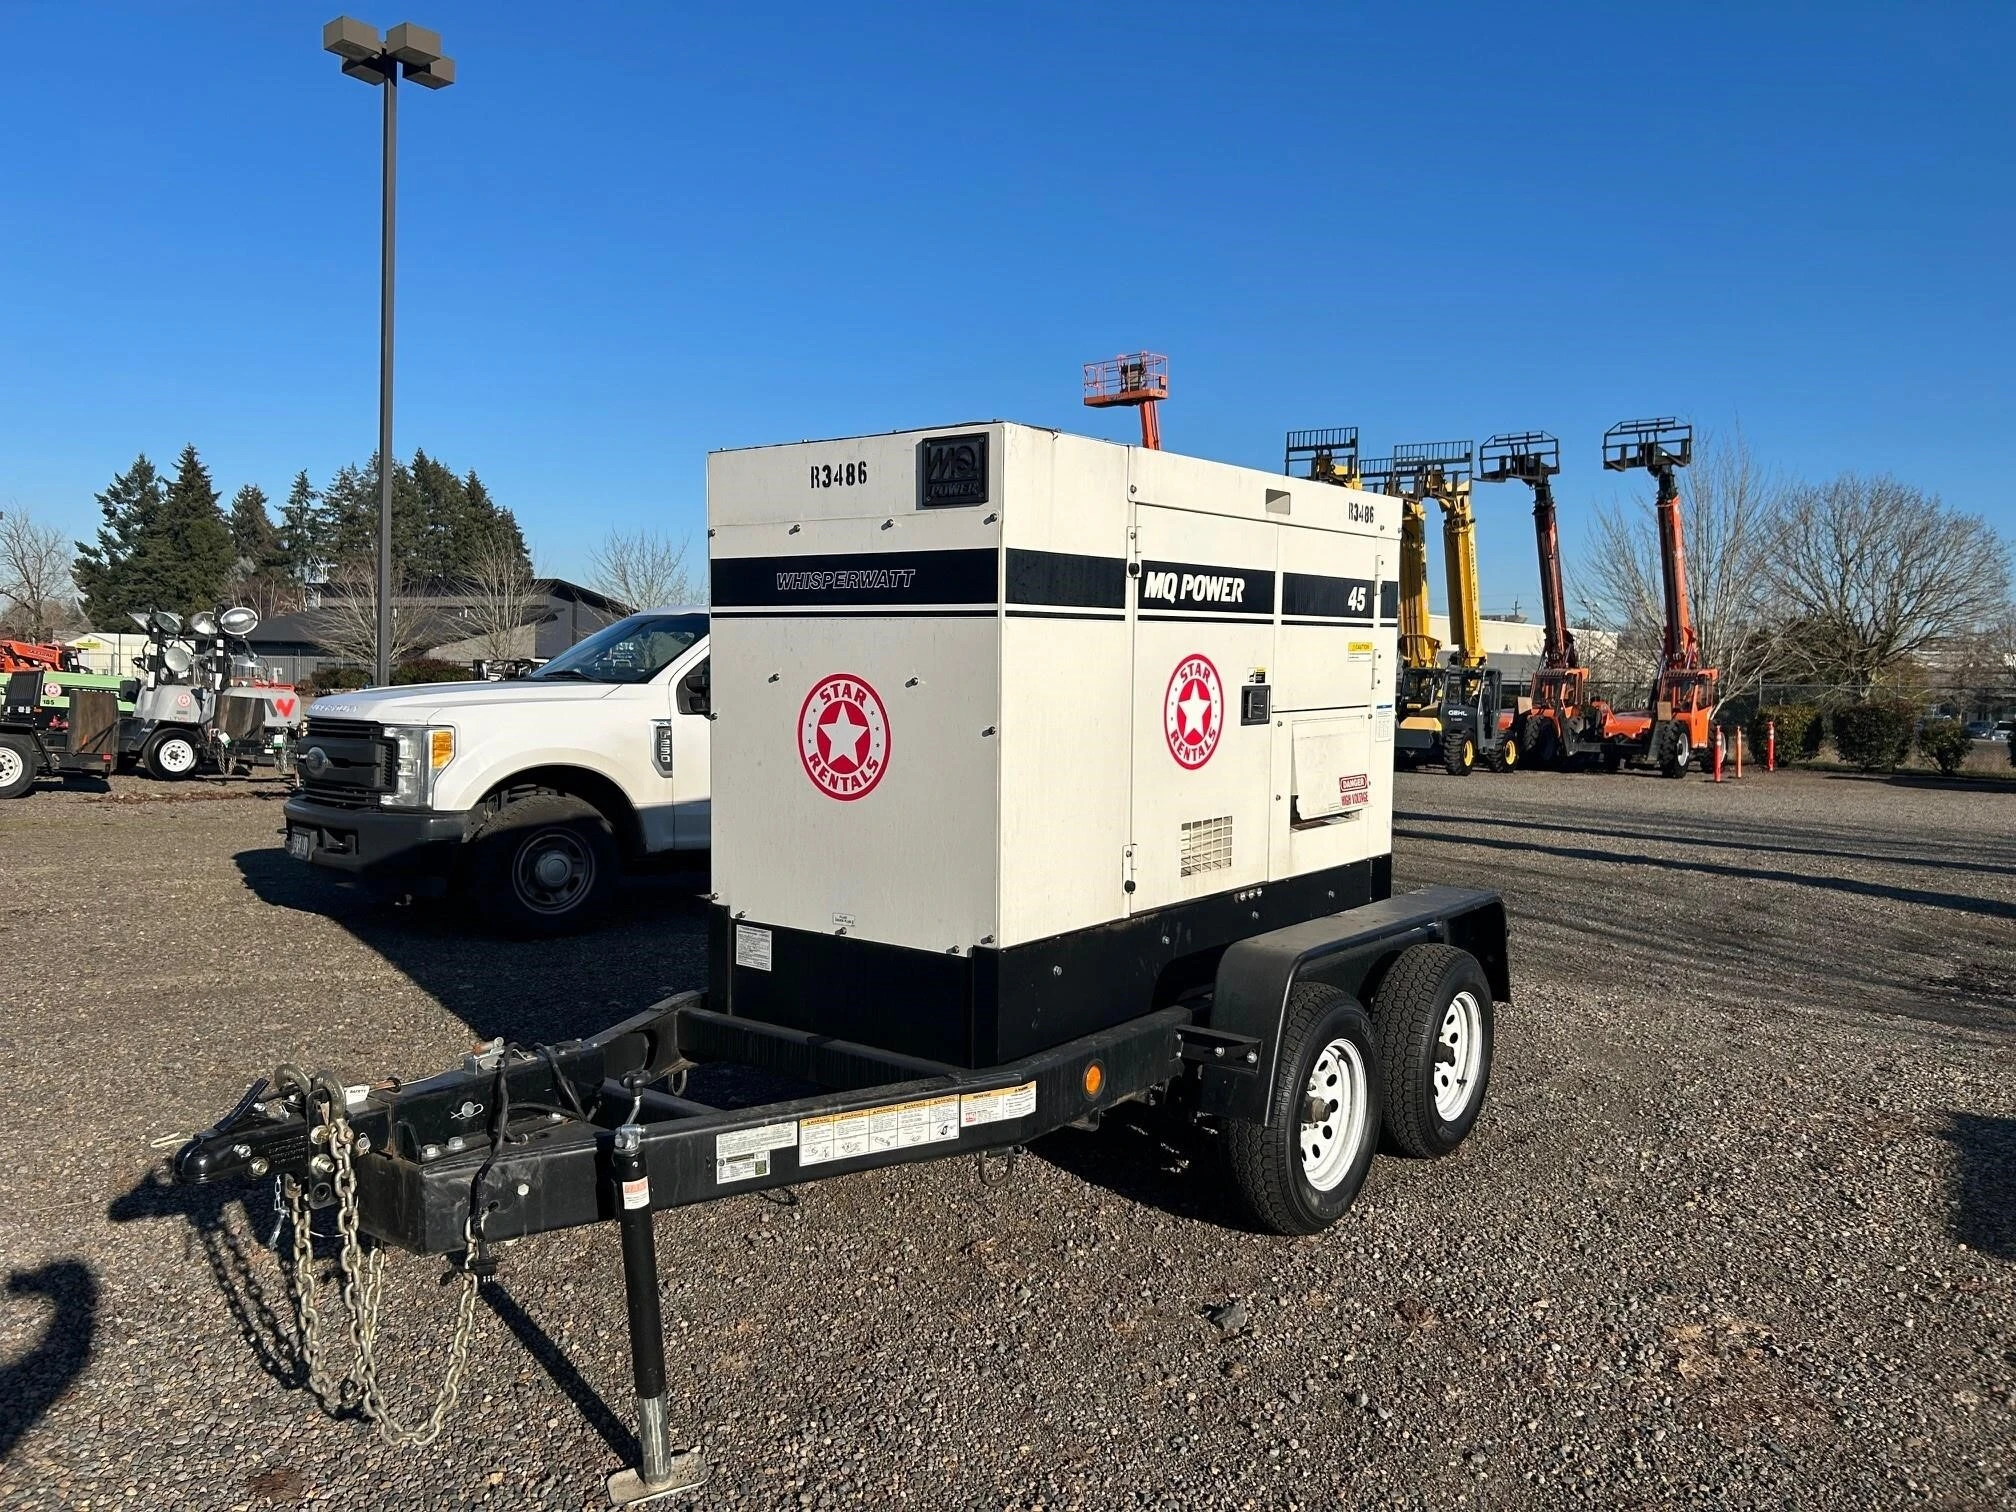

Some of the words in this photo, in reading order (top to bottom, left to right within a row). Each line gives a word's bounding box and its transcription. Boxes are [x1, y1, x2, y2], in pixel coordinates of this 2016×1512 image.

[810, 461, 868, 489] R3486
[931, 482, 978, 497] POWER
[1348, 501, 1375, 524] R3486
[776, 569, 916, 591] WHISPERWATT
[1144, 571, 1178, 604] MQ
[1179, 573, 1246, 603] POWER
[1347, 586, 1367, 612] 45
[1180, 662, 1211, 684] STAR
[819, 683, 867, 708] STAR
[1170, 727, 1217, 762] RENTALS
[808, 752, 880, 792] RENTALS
[1342, 777, 1365, 790] DANGER
[1341, 794, 1351, 806] HIGH
[1352, 791, 1369, 805] VOLTAGE
